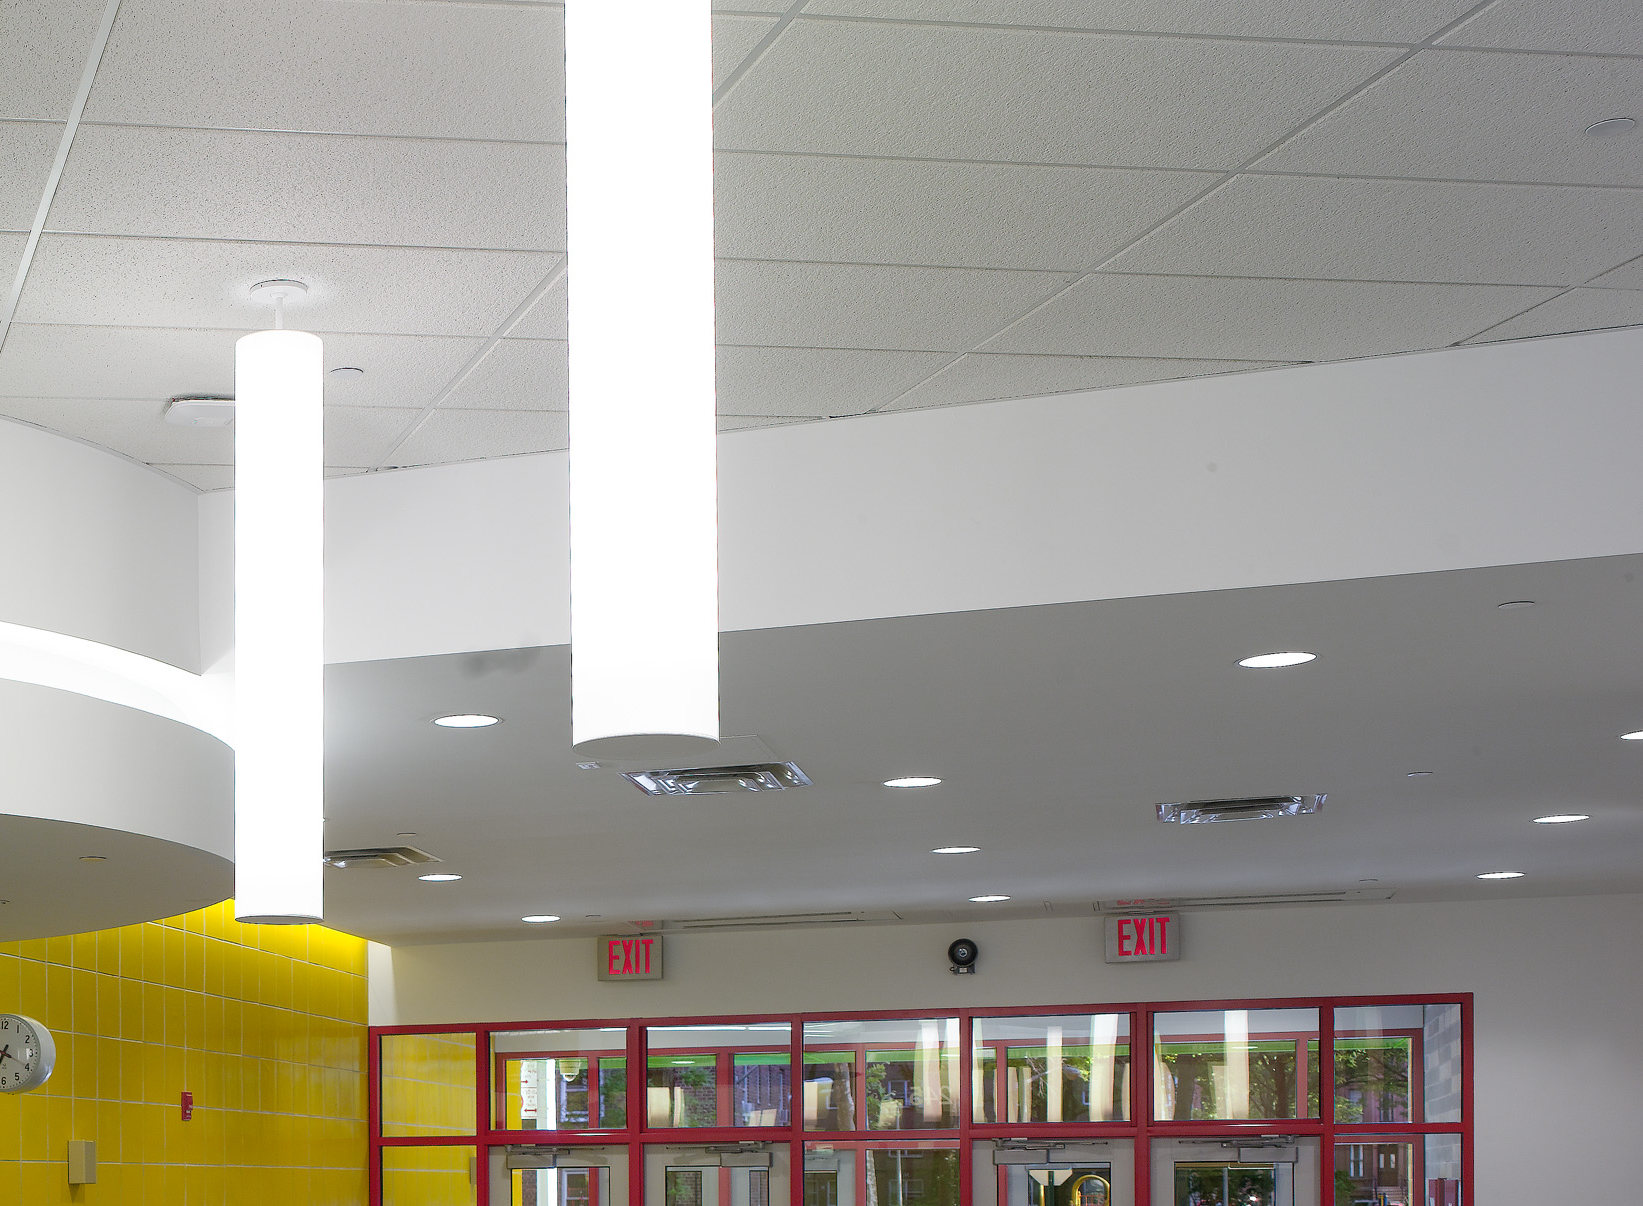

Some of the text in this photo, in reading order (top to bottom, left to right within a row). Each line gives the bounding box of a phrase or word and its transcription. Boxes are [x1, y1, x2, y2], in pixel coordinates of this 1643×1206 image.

[1118, 917, 1170, 956] EXIT
[608, 939, 654, 975] EXIT
[1, 1021, 9, 1030] 12
[16, 1025, 20, 1034] 1
[25, 1035, 30, 1044] 2
[28, 1049, 34, 1058] 3
[24, 1063, 30, 1071] 4
[1, 1077, 7, 1085] 6
[14, 1073, 20, 1081] 5
